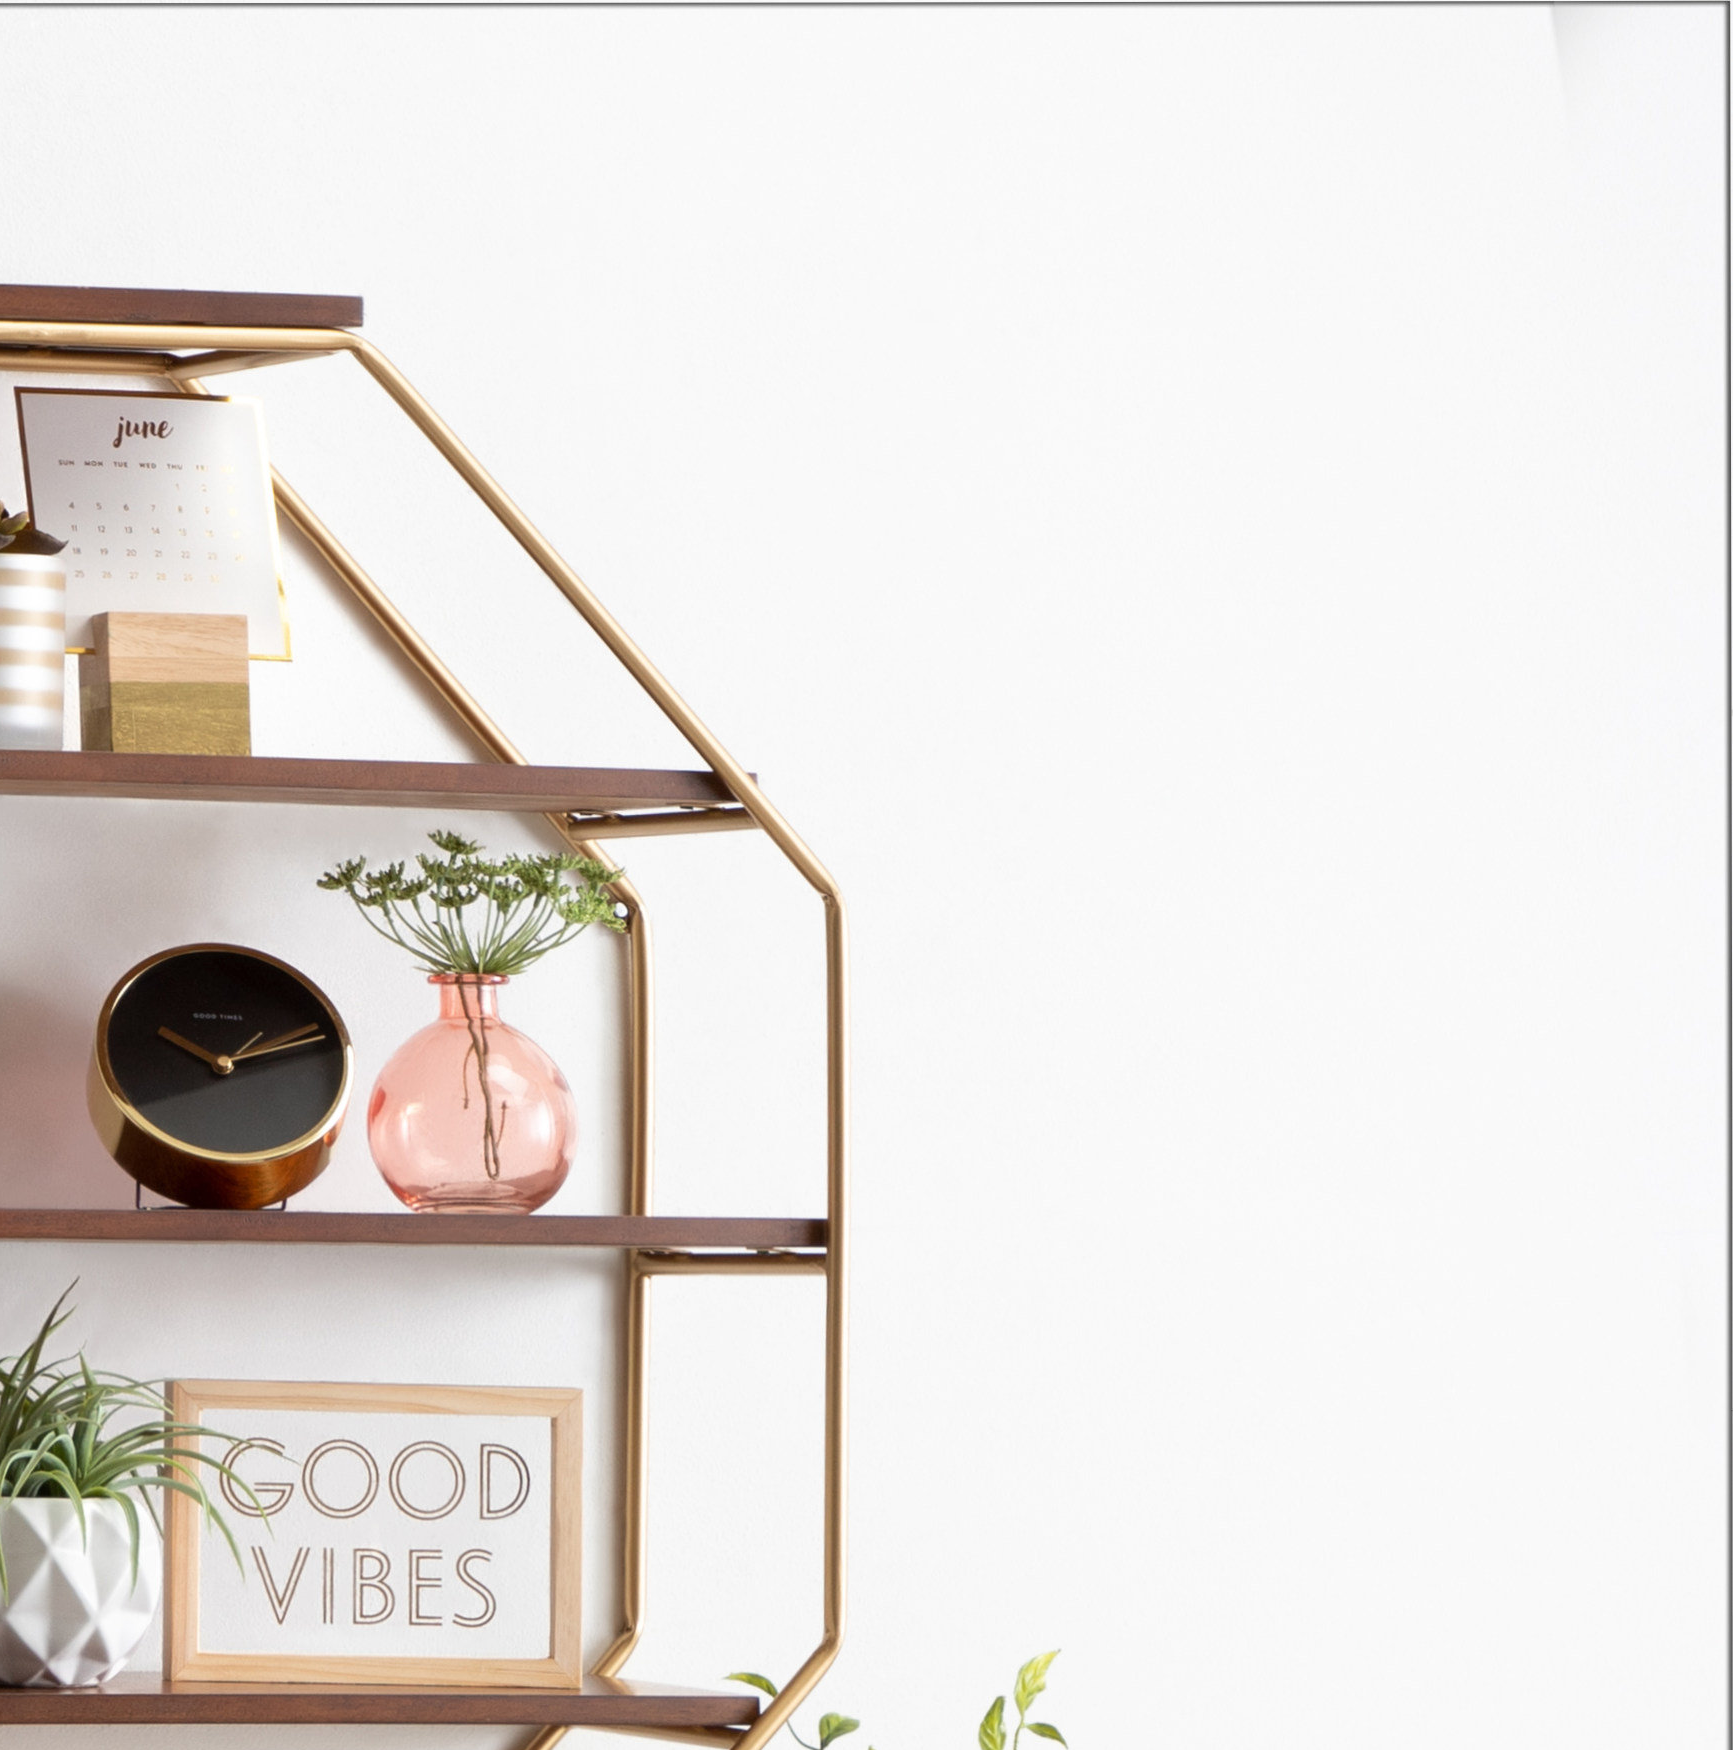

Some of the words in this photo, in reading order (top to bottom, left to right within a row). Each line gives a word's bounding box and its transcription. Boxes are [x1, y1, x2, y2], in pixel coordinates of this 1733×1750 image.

[112, 416, 174, 448] june
[71, 524, 78, 532] 11
[97, 525, 106, 534] 12
[124, 526, 133, 534] 13
[151, 527, 160, 535] 14
[72, 547, 81, 555] 18
[100, 548, 109, 556] 19
[126, 549, 137, 557] 20
[154, 550, 162, 558] 21
[181, 551, 190, 559] 22
[74, 569, 84, 578] 25
[102, 570, 112, 579] 26
[129, 571, 139, 580] 27
[193, 1012, 216, 1020] GOOD
[219, 1013, 243, 1021] TIMES
[219, 1437, 531, 1520] GOOD
[251, 1545, 497, 1628] VIBES
